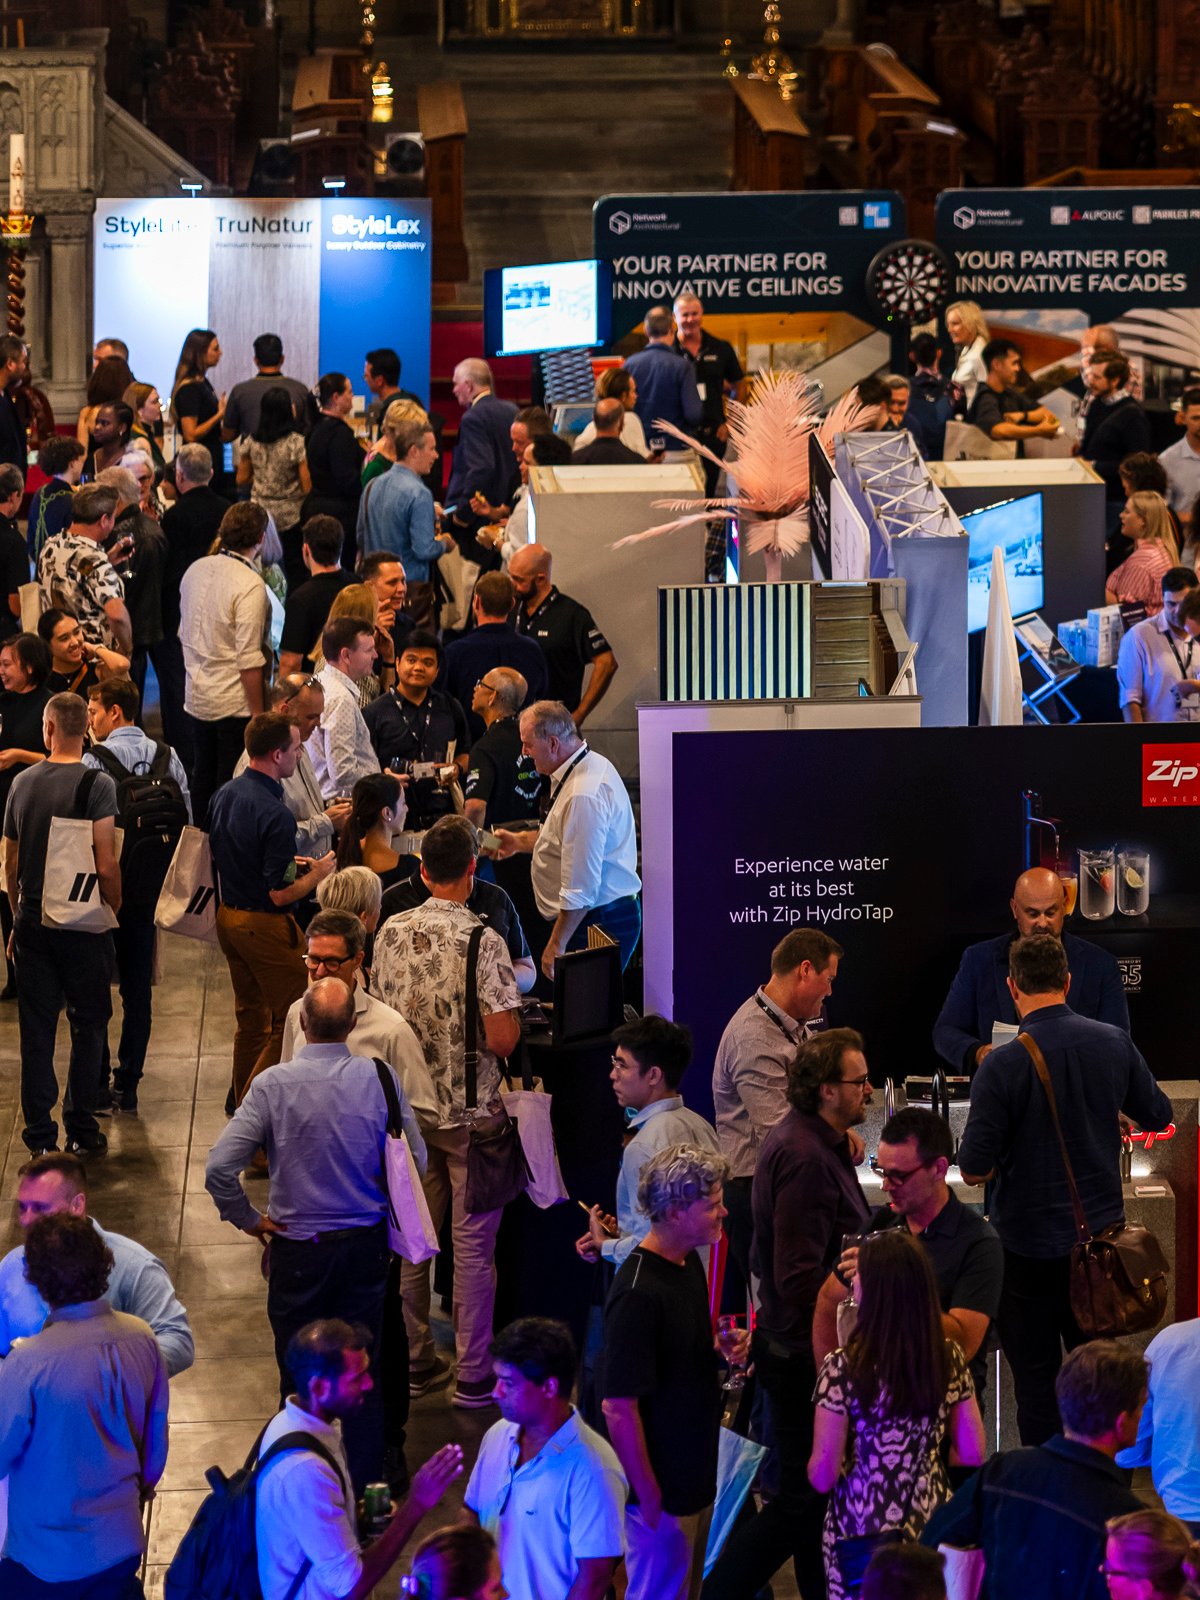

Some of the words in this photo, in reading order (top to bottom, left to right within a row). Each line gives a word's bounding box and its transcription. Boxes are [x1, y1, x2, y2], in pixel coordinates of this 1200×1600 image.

[976, 208, 1011, 217] Network
[216, 216, 313, 233] TruNatur
[332, 214, 420, 240] StyleLex
[613, 255, 672, 275] YOUR
[677, 253, 778, 274] PARTNER
[783, 252, 828, 271] FOR
[954, 251, 1015, 269] YOUR
[1020, 250, 1119, 268] PARTNER
[1124, 249, 1168, 268] FOR
[613, 278, 741, 299] INNOVATIVE
[746, 276, 843, 297] CEILINGS
[955, 274, 1083, 293] INNOVATIVE
[1088, 273, 1187, 292] FACADES
[1146, 759, 1199, 787] Zip
[1149, 795, 1198, 803] WATER
[735, 857, 834, 877] Experience
[838, 856, 889, 871] water
[769, 883, 786, 898] at
[791, 881, 811, 897] its
[816, 879, 855, 896] best
[729, 905, 768, 923] with
[773, 906, 801, 926] Zip
[806, 903, 894, 925] HydroTap
